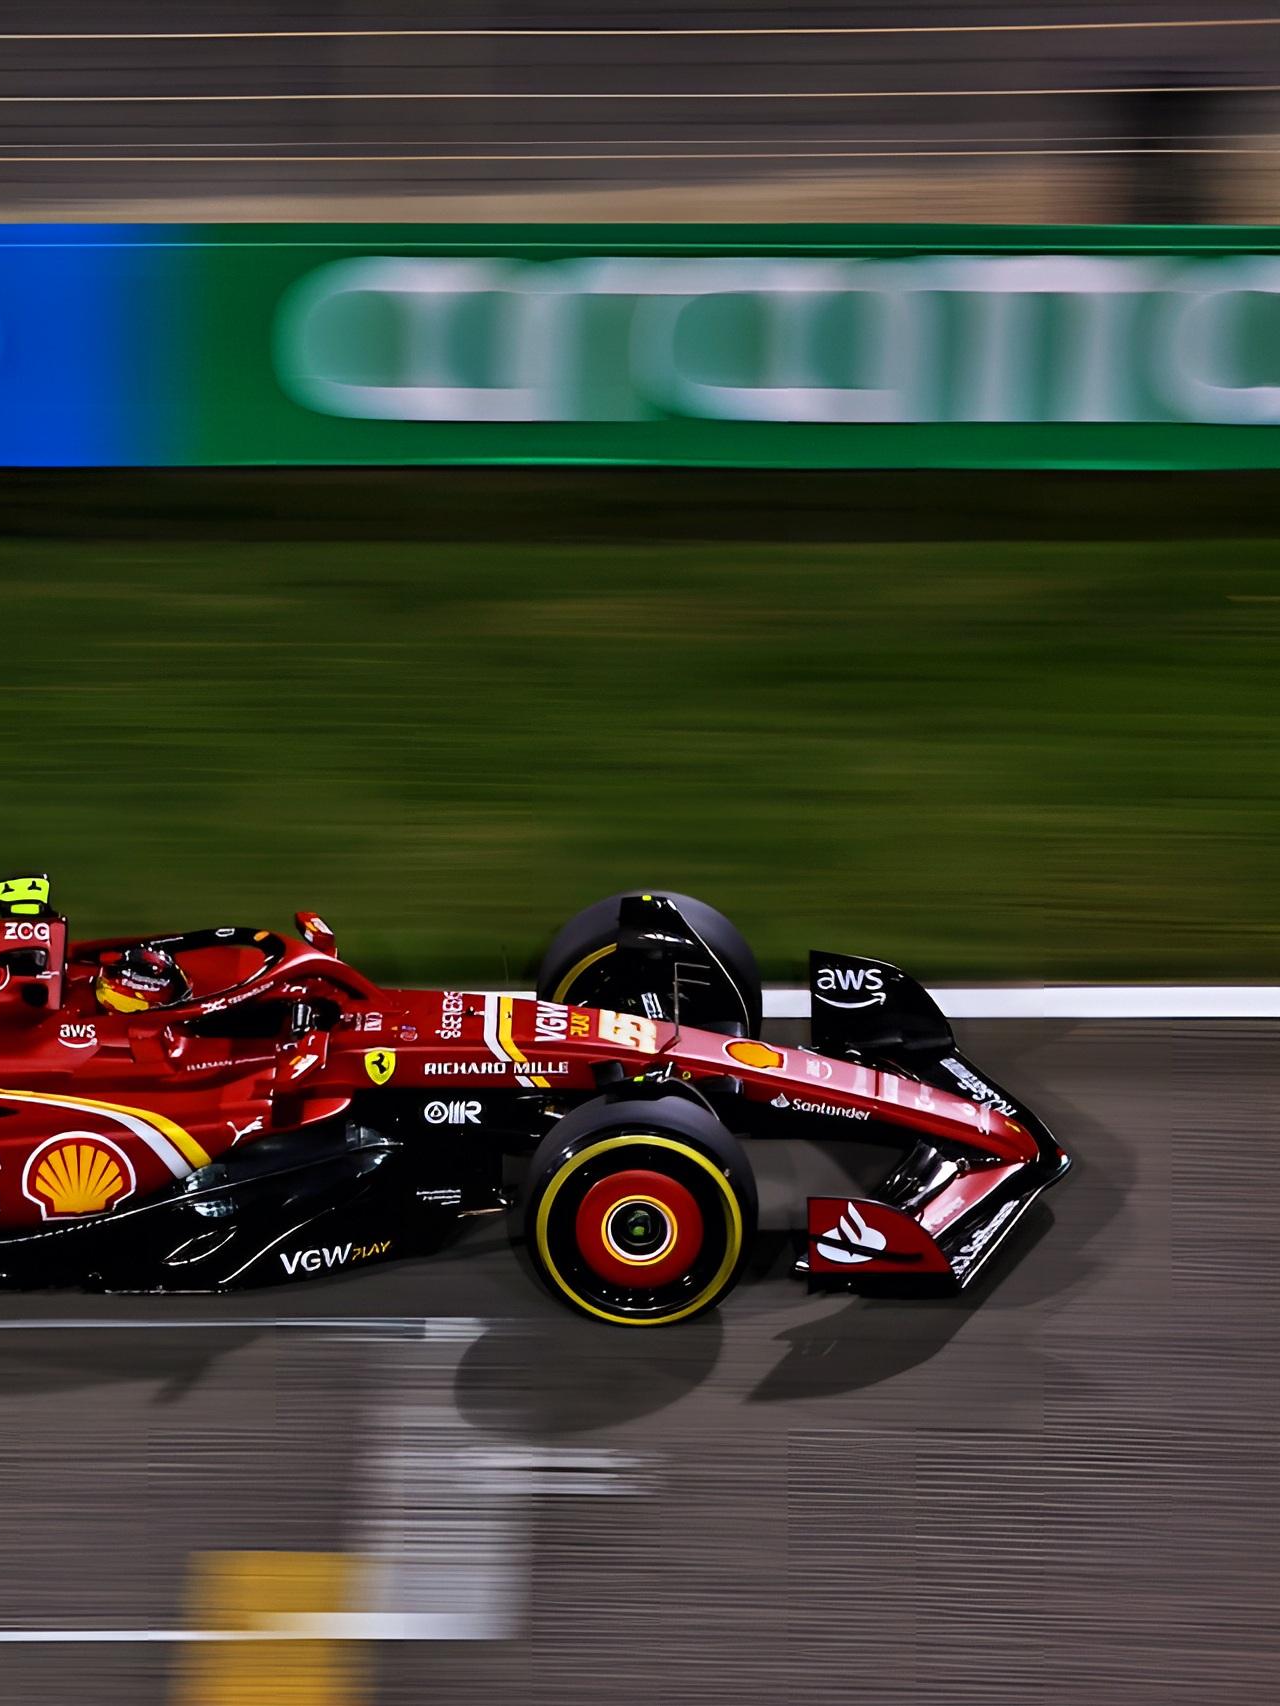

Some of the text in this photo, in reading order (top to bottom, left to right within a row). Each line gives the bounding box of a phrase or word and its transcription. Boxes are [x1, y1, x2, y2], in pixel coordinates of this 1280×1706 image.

[817, 969, 884, 990] aws
[59, 1024, 96, 1038] aws
[534, 1000, 569, 1042] VGW
[424, 1062, 569, 1076] RICHARD MILLE
[792, 1098, 871, 1121] Santander
[280, 1243, 353, 1275] VGW
